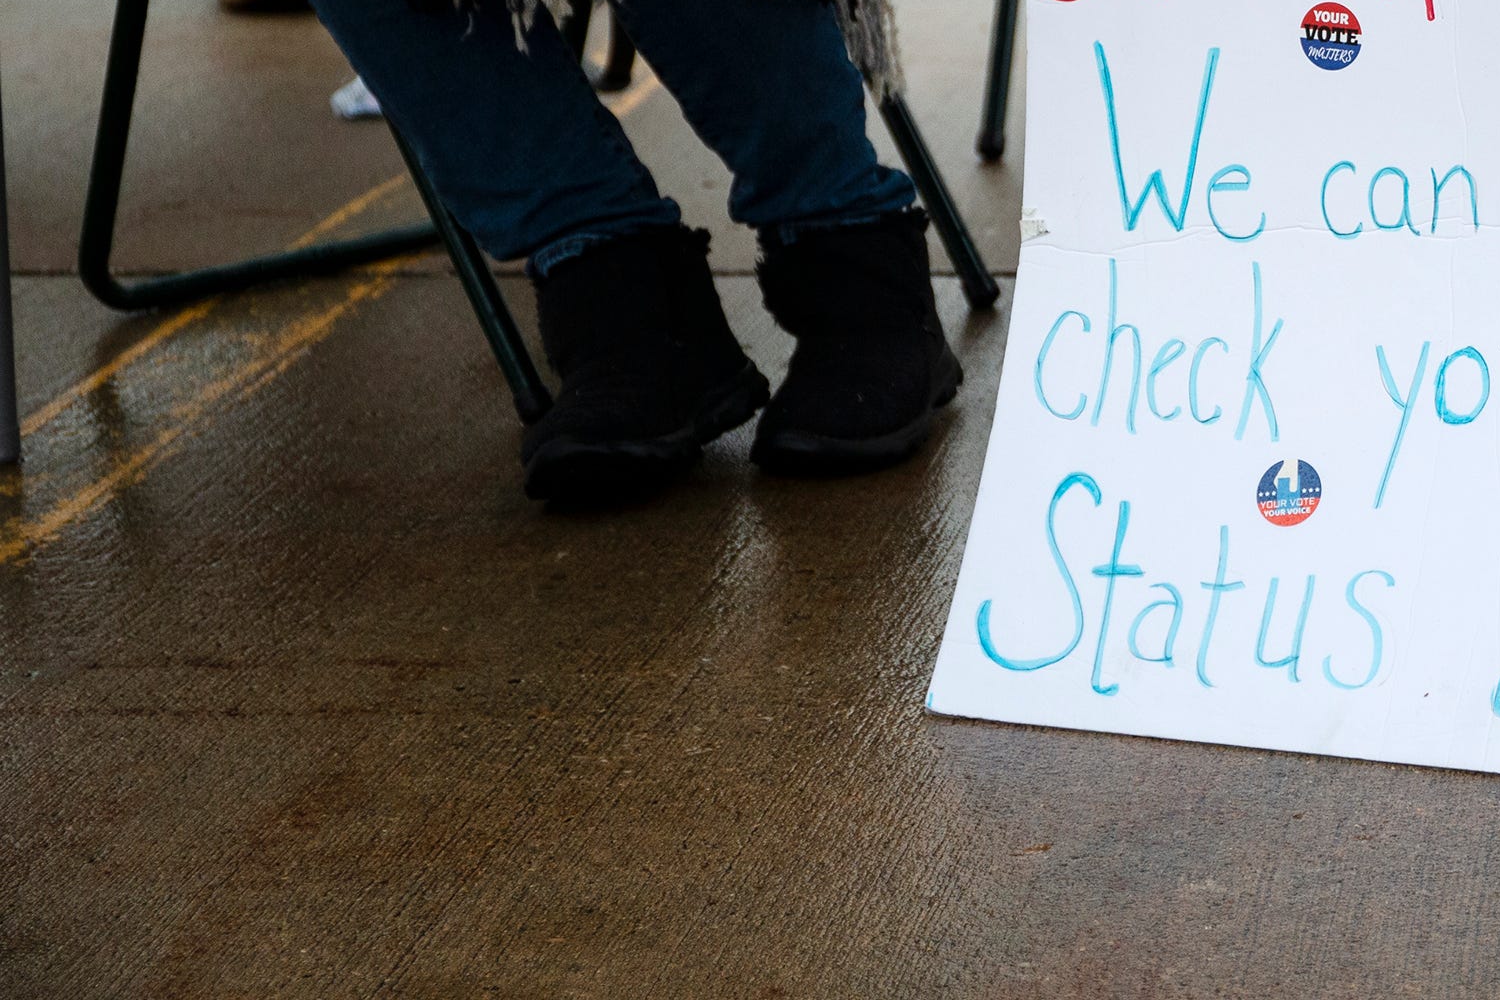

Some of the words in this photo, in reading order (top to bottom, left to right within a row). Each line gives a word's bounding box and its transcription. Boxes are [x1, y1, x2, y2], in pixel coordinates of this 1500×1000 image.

[1313, 10, 1350, 25] YOUR
[1304, 24, 1359, 46] VOTE
[1092, 40, 1268, 245] We
[1320, 158, 1482, 242] can
[1260, 499, 1287, 509] YOUR
[1289, 497, 1315, 507] VOTE
[1263, 508, 1286, 517] YOUR
[1286, 506, 1311, 516] VOICE
